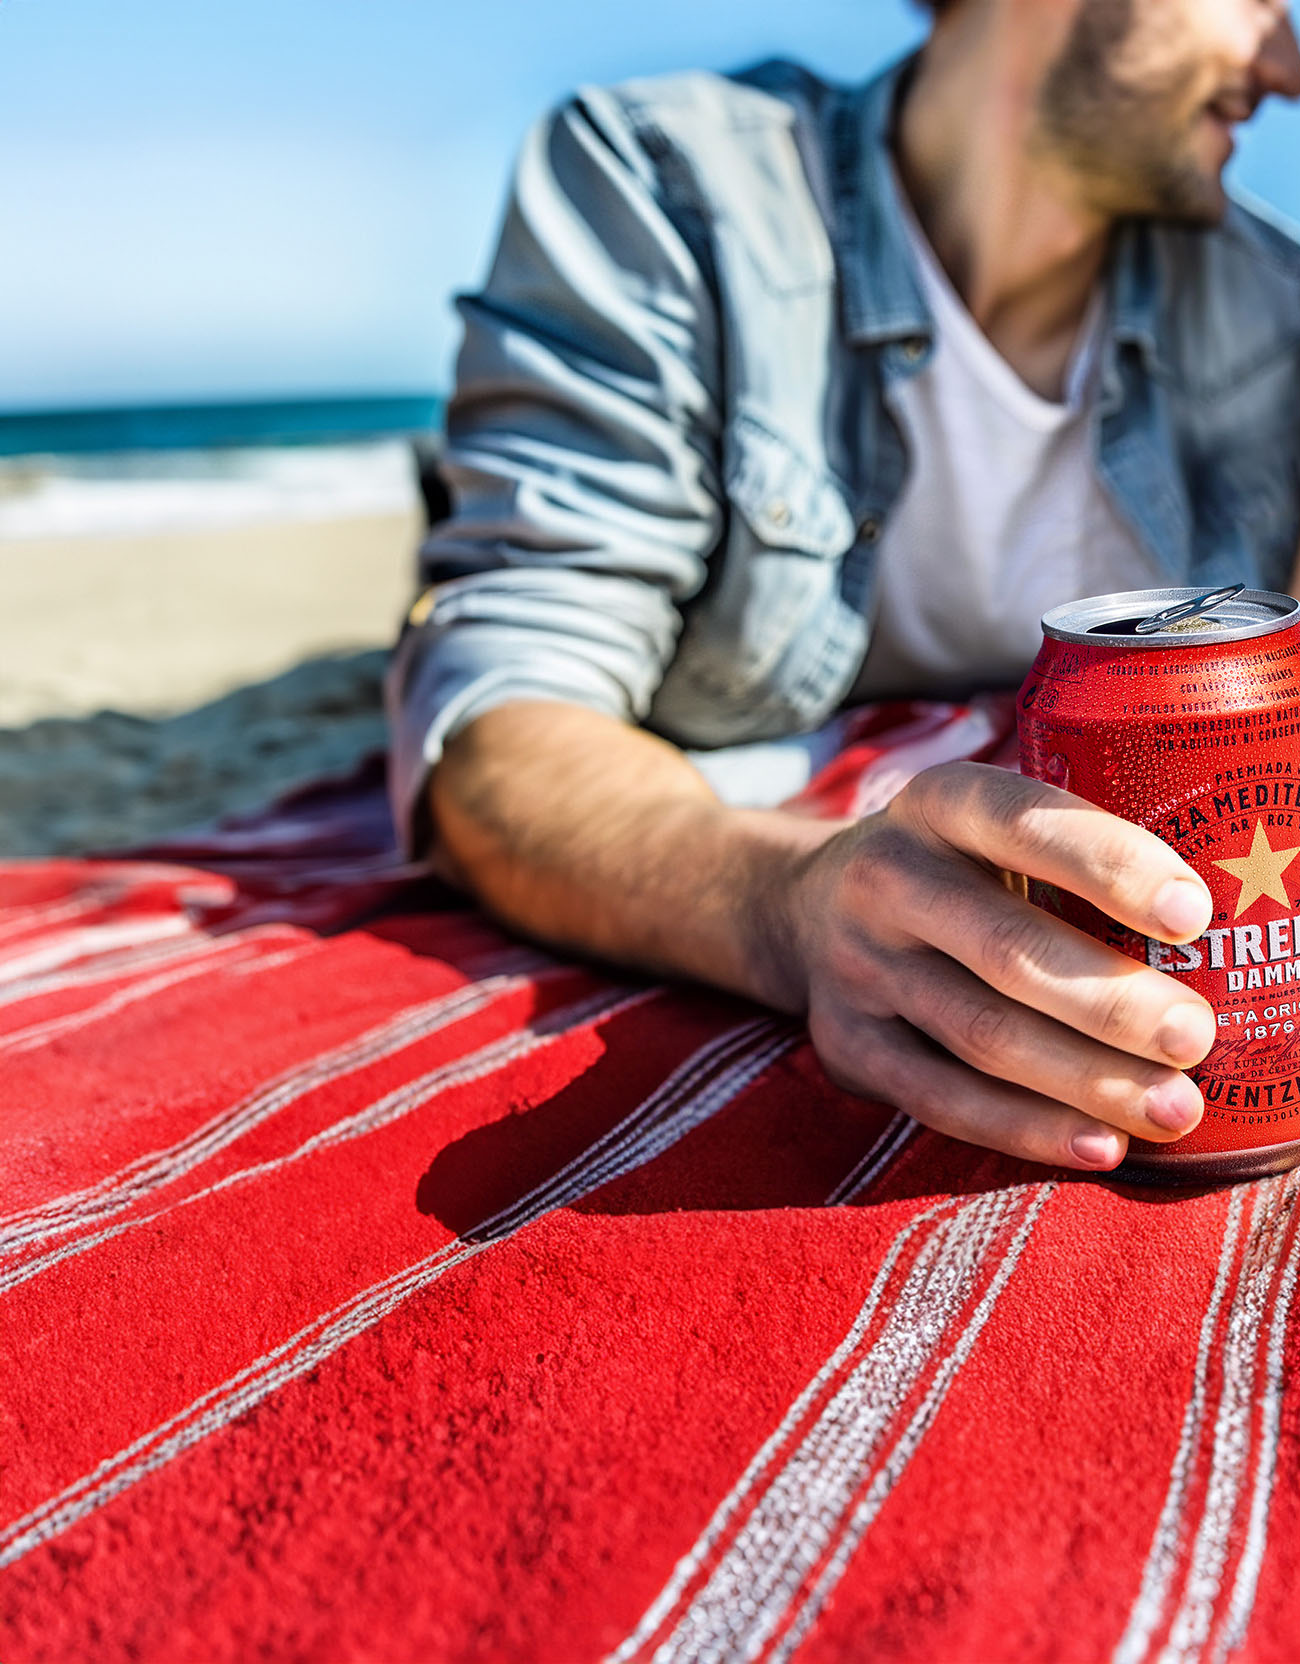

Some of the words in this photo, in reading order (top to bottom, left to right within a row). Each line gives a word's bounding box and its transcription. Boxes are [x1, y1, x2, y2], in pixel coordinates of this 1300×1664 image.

[1148, 664, 1160, 676] DE
[1188, 711, 1271, 734] INGREDIENTES
[1181, 734, 1237, 751] ADITIVOS
[1243, 731, 1254, 744] NI
[1216, 762, 1293, 786] PREMIADA
[1175, 832, 1222, 861] ALTA,
[1251, 994, 1266, 1003] EN
[1216, 1009, 1259, 1027] ETA
[1243, 1019, 1295, 1041] 1876
[1207, 1109, 1226, 1120] 201
[1231, 1106, 1300, 1125] STOCKHOLM
